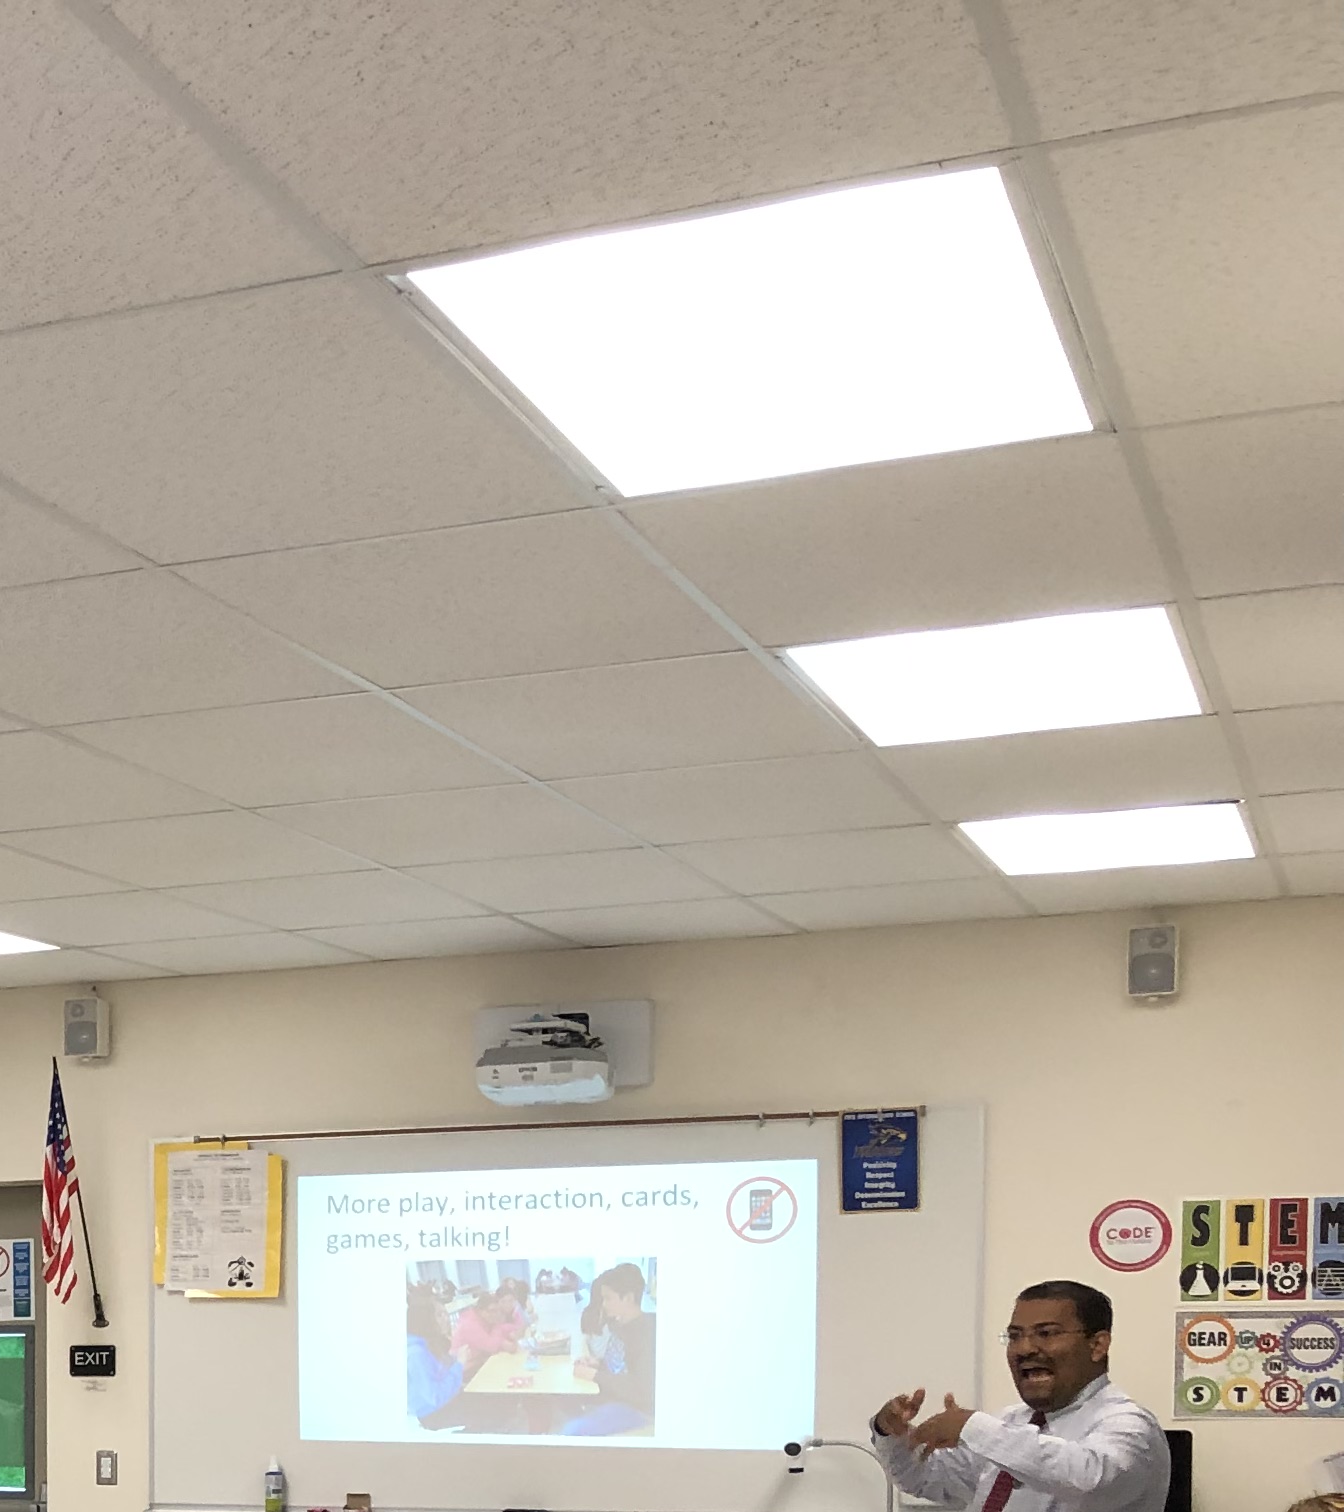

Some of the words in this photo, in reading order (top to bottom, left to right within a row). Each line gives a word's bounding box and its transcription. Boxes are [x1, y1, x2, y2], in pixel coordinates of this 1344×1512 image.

[327, 1195, 390, 1215] More
[399, 1192, 455, 1218] play,
[464, 1188, 612, 1212] interaction,
[621, 1184, 699, 1210] cards,
[326, 1229, 410, 1254] games,
[418, 1226, 510, 1252] talking!
[1106, 1226, 1153, 1239] CODE
[1187, 1331, 1228, 1347] GEAR
[1240, 1335, 1253, 1345] UP
[1262, 1338, 1271, 1347] 4
[1290, 1337, 1336, 1350] SUCCESS
[75, 1352, 109, 1365] EXIT
[1269, 1362, 1282, 1371] IN
